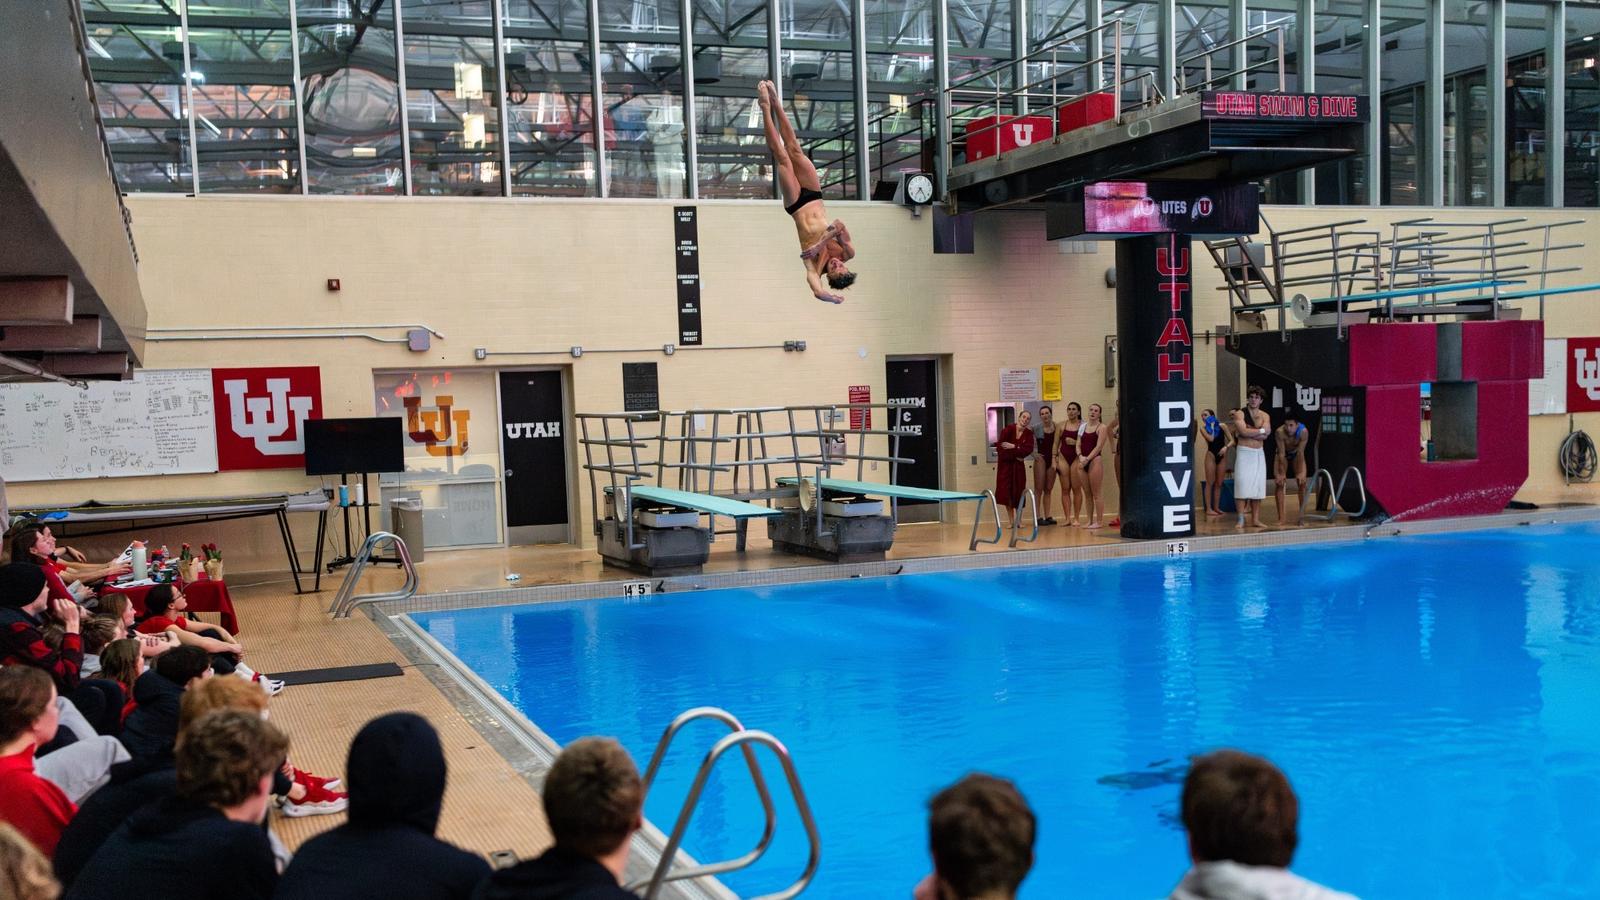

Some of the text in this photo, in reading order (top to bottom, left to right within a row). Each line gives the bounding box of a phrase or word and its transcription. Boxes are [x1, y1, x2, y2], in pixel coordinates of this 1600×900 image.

[1215, 93, 1358, 117] UTAH SWIM & DIVE
[1012, 123, 1033, 147] U
[1161, 200, 1187, 214] UTES
[1156, 247, 1191, 533] UTAH DIVE
[505, 422, 561, 439] UTAH
[1178, 543, 1184, 552] 5
[624, 584, 646, 596] 14 5
